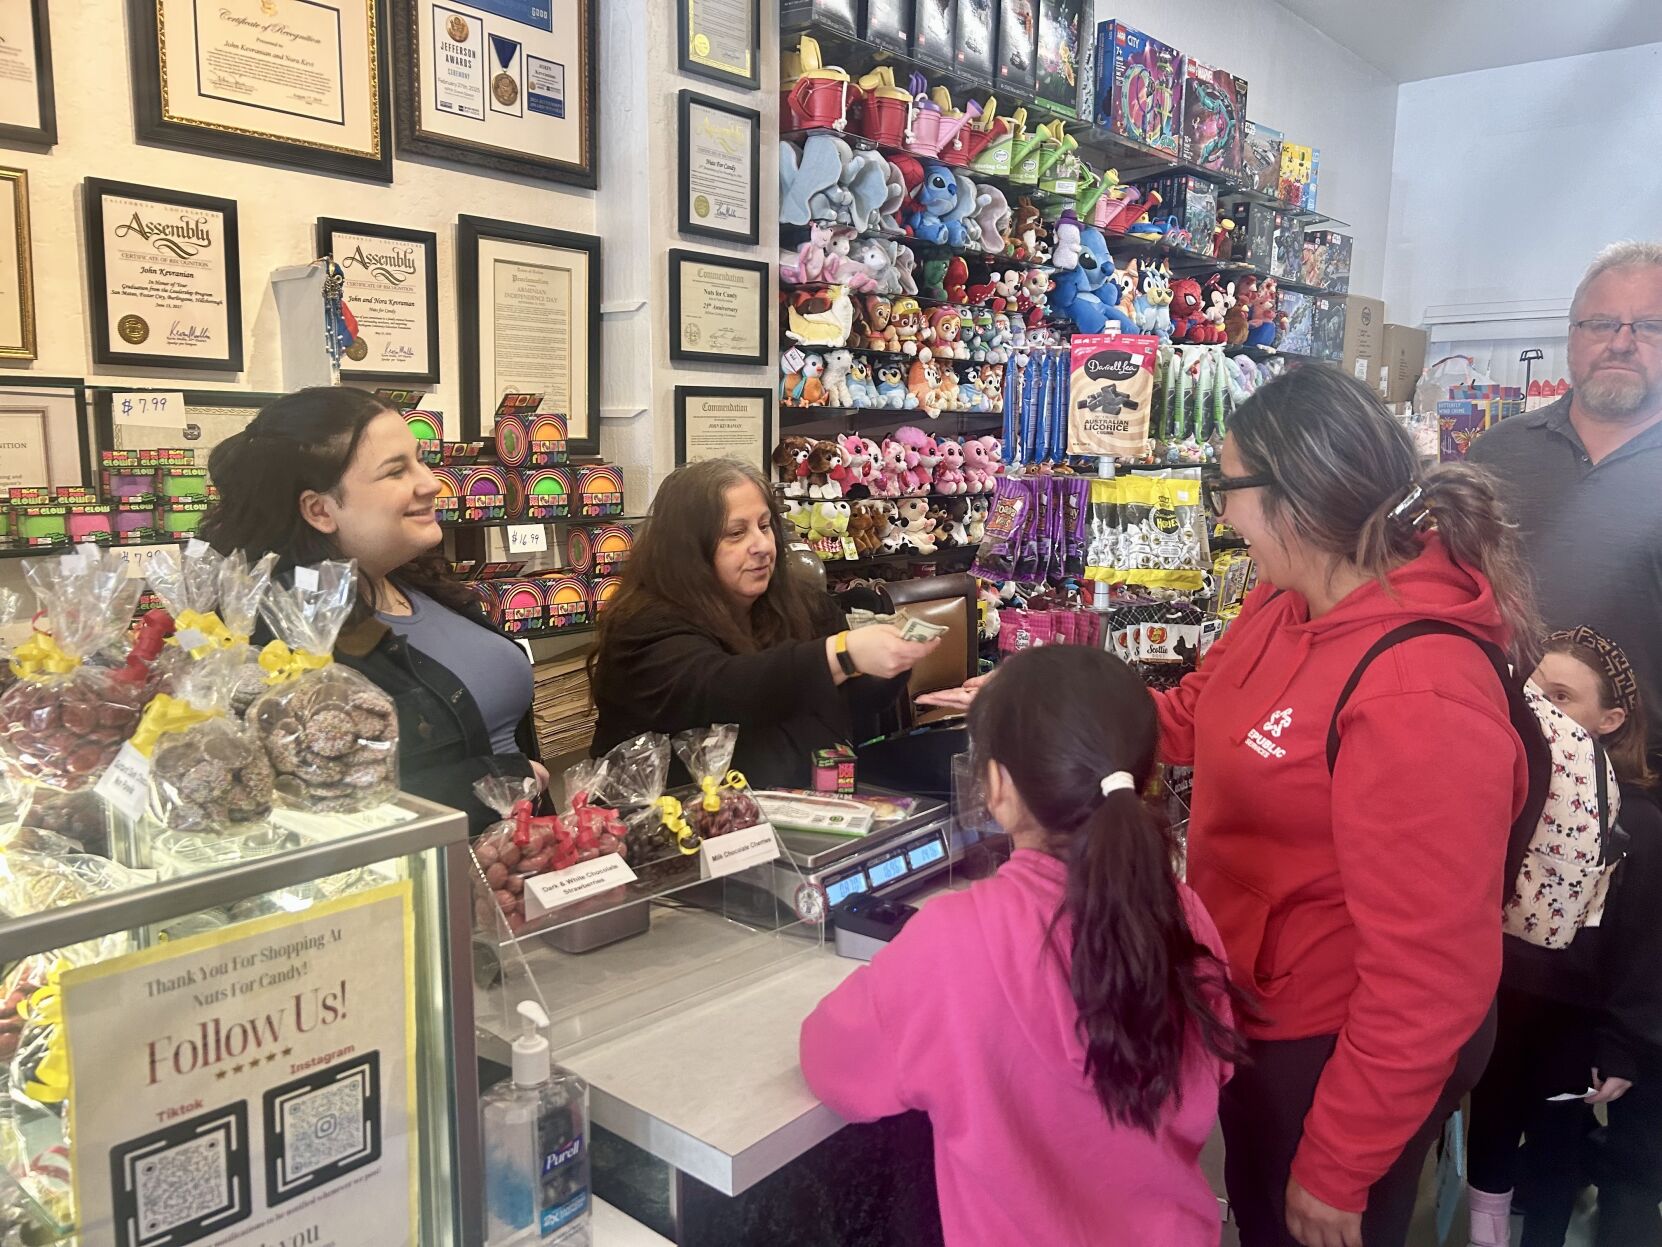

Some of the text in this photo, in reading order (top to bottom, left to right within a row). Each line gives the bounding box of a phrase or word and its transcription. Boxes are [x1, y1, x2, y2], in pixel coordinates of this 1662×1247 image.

[440, 41, 476, 59] JEFFERSON
[446, 54, 472, 69] AWARDS
[115, 211, 212, 250] Assembly
[140, 266, 157, 275] John
[342, 245, 416, 278] Assembly
[1084, 424, 1129, 432] LICORICE
[1147, 645, 1168, 654] Scottie
[542, 883, 558, 893] Dark
[567, 875, 585, 884] White
[586, 864, 618, 878] Chocolate
[563, 878, 605, 894] Strawberries
[146, 928, 342, 997] Thank You For Shopping At
[193, 961, 308, 1008] Nuts For Candy!
[146, 980, 347, 1087] Follow Us!
[290, 1044, 355, 1075] Instagram
[156, 1098, 205, 1122] Tiktok
[546, 1139, 580, 1170] Purell
